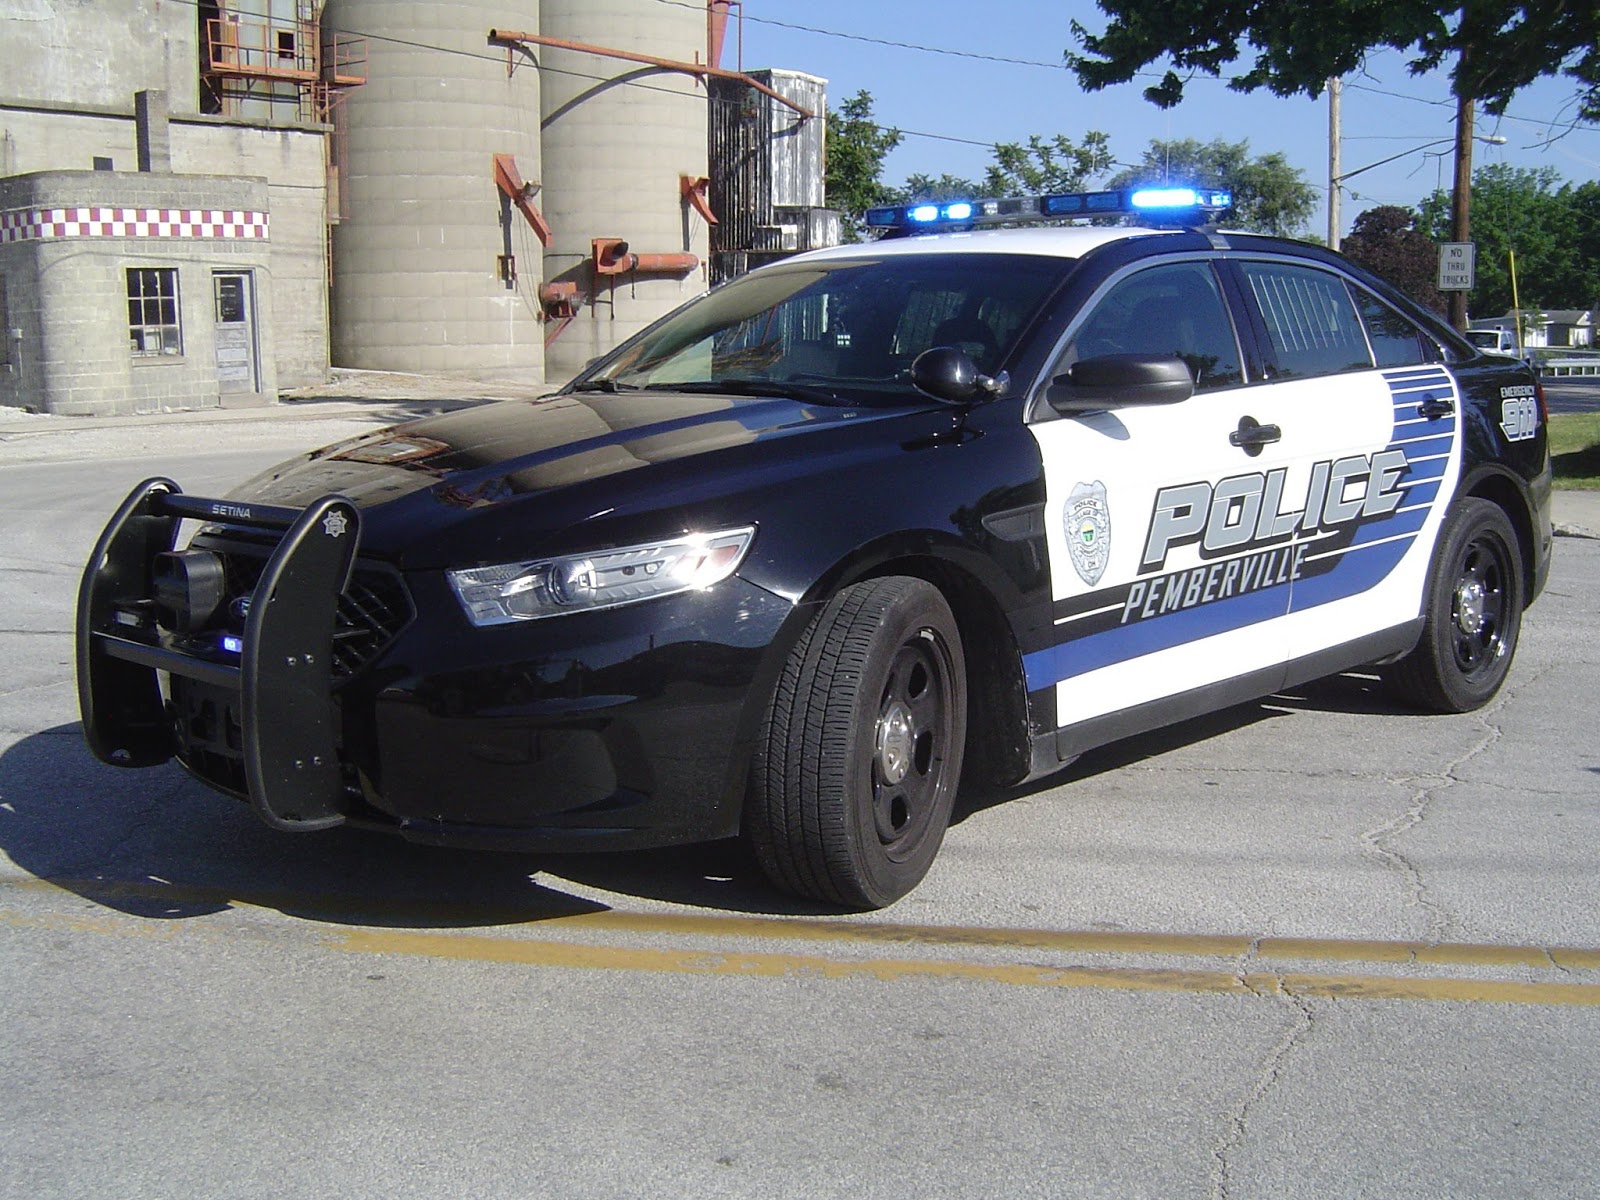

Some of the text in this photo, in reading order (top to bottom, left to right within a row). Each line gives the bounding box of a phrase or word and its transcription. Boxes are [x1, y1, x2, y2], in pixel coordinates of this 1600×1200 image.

[1450, 248, 1463, 258] NO
[1447, 262, 1465, 271] THRU
[1442, 275, 1469, 285] TRUCKS
[1500, 385, 1535, 398] EMERGENCY
[1499, 397, 1537, 442] 911
[211, 504, 251, 519] SETINA
[1074, 500, 1098, 511] POLICE
[1138, 450, 1412, 576] POLICE
[1120, 544, 1309, 623] PEMBERVILLE
